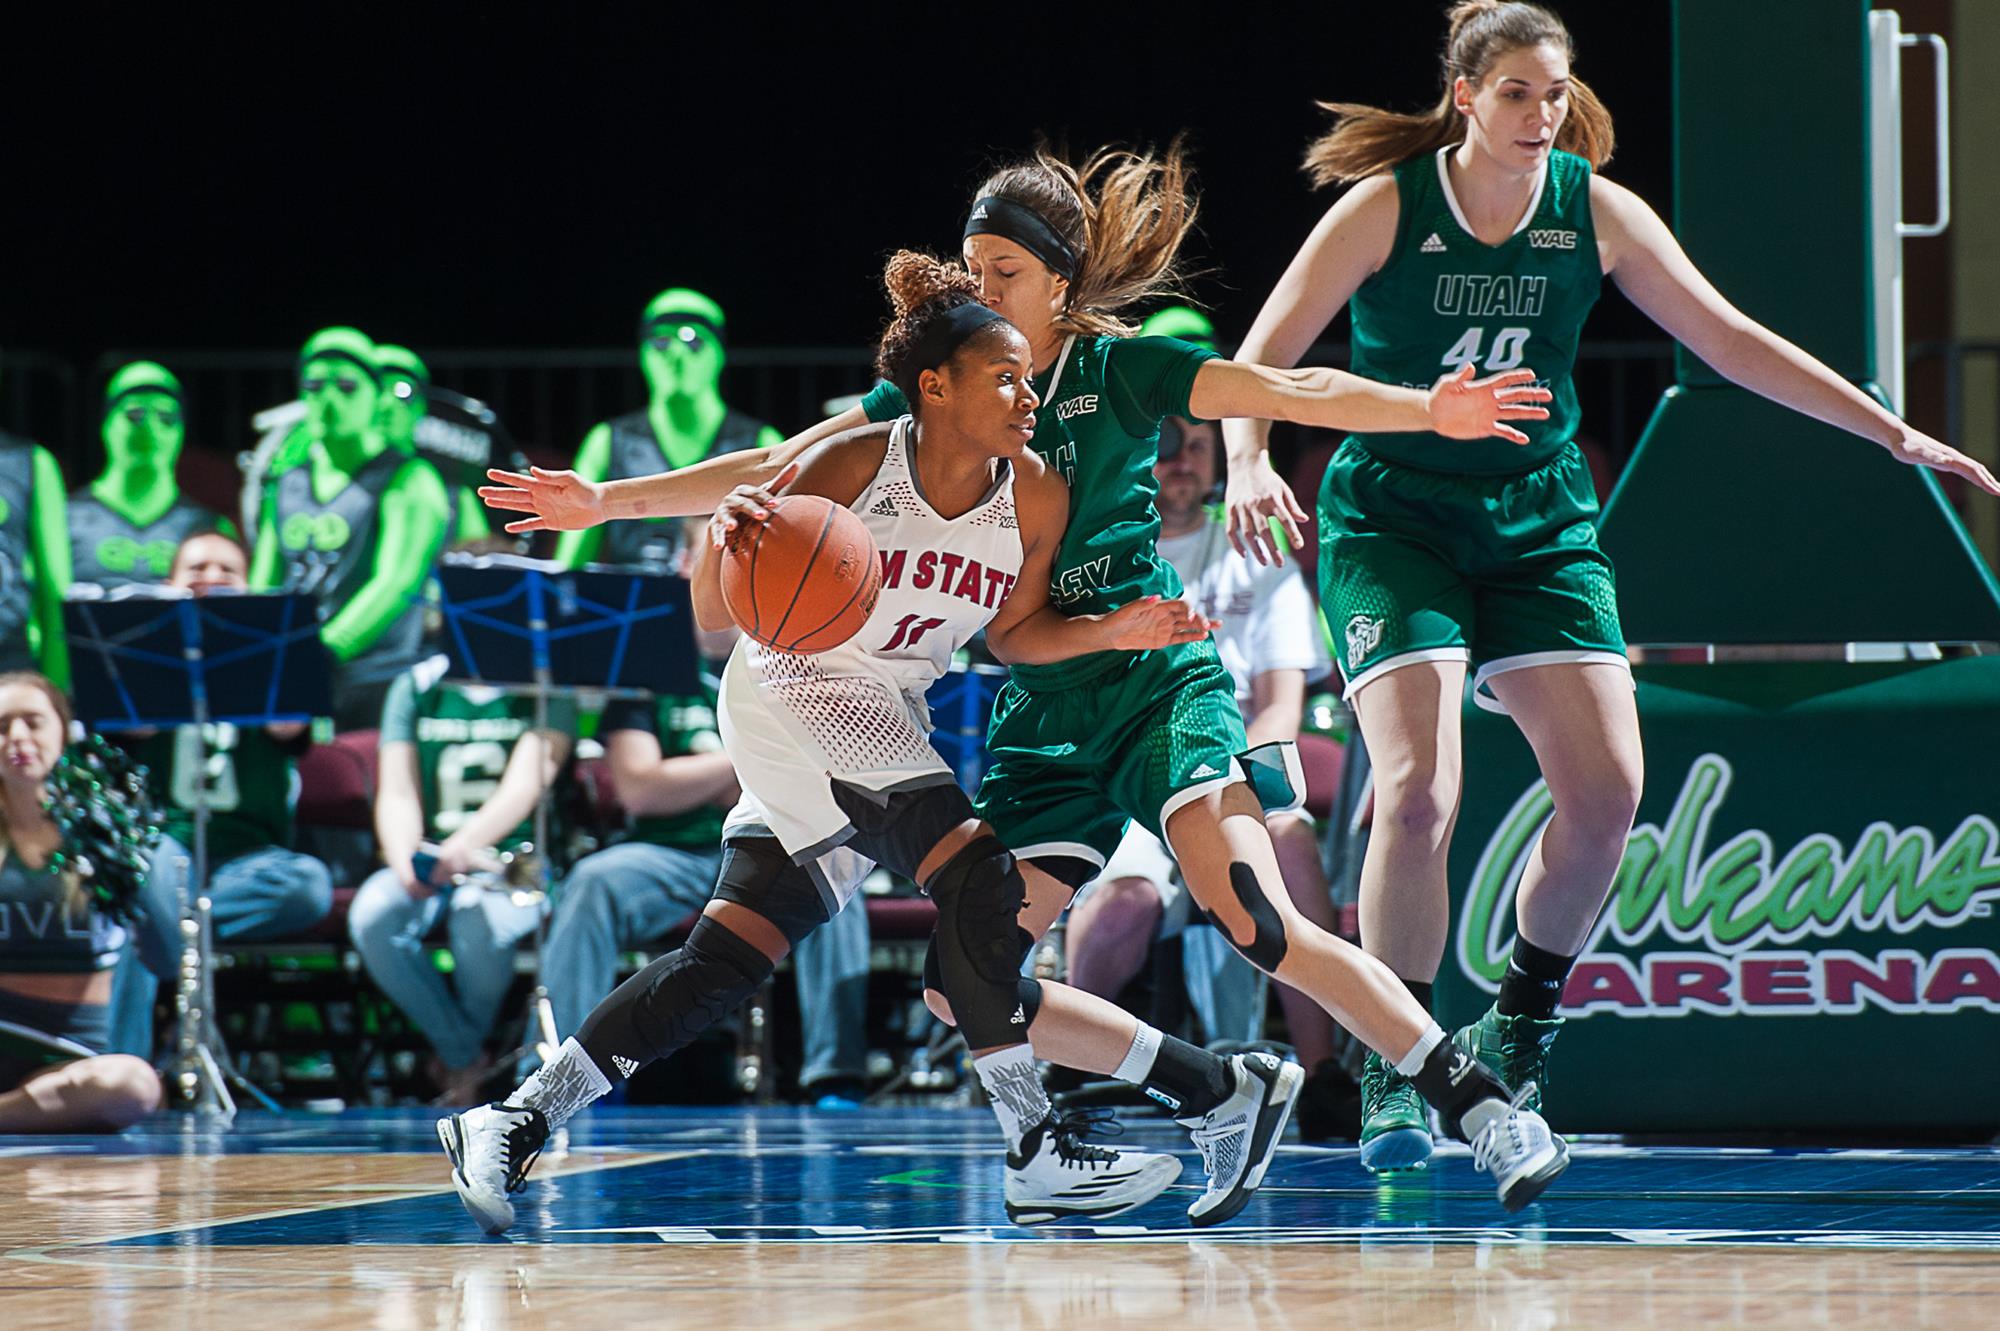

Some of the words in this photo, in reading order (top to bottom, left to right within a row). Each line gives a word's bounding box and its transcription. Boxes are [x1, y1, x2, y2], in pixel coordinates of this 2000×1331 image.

[1529, 229, 1577, 249] WAC
[1434, 274, 1547, 316] UTAH
[1441, 327, 1531, 372] 40
[1056, 394, 1098, 420] WAC
[870, 507, 899, 517] adidas
[879, 550, 907, 589] M
[912, 550, 1016, 609] STATE
[1557, 953, 2000, 1013] ARENA
